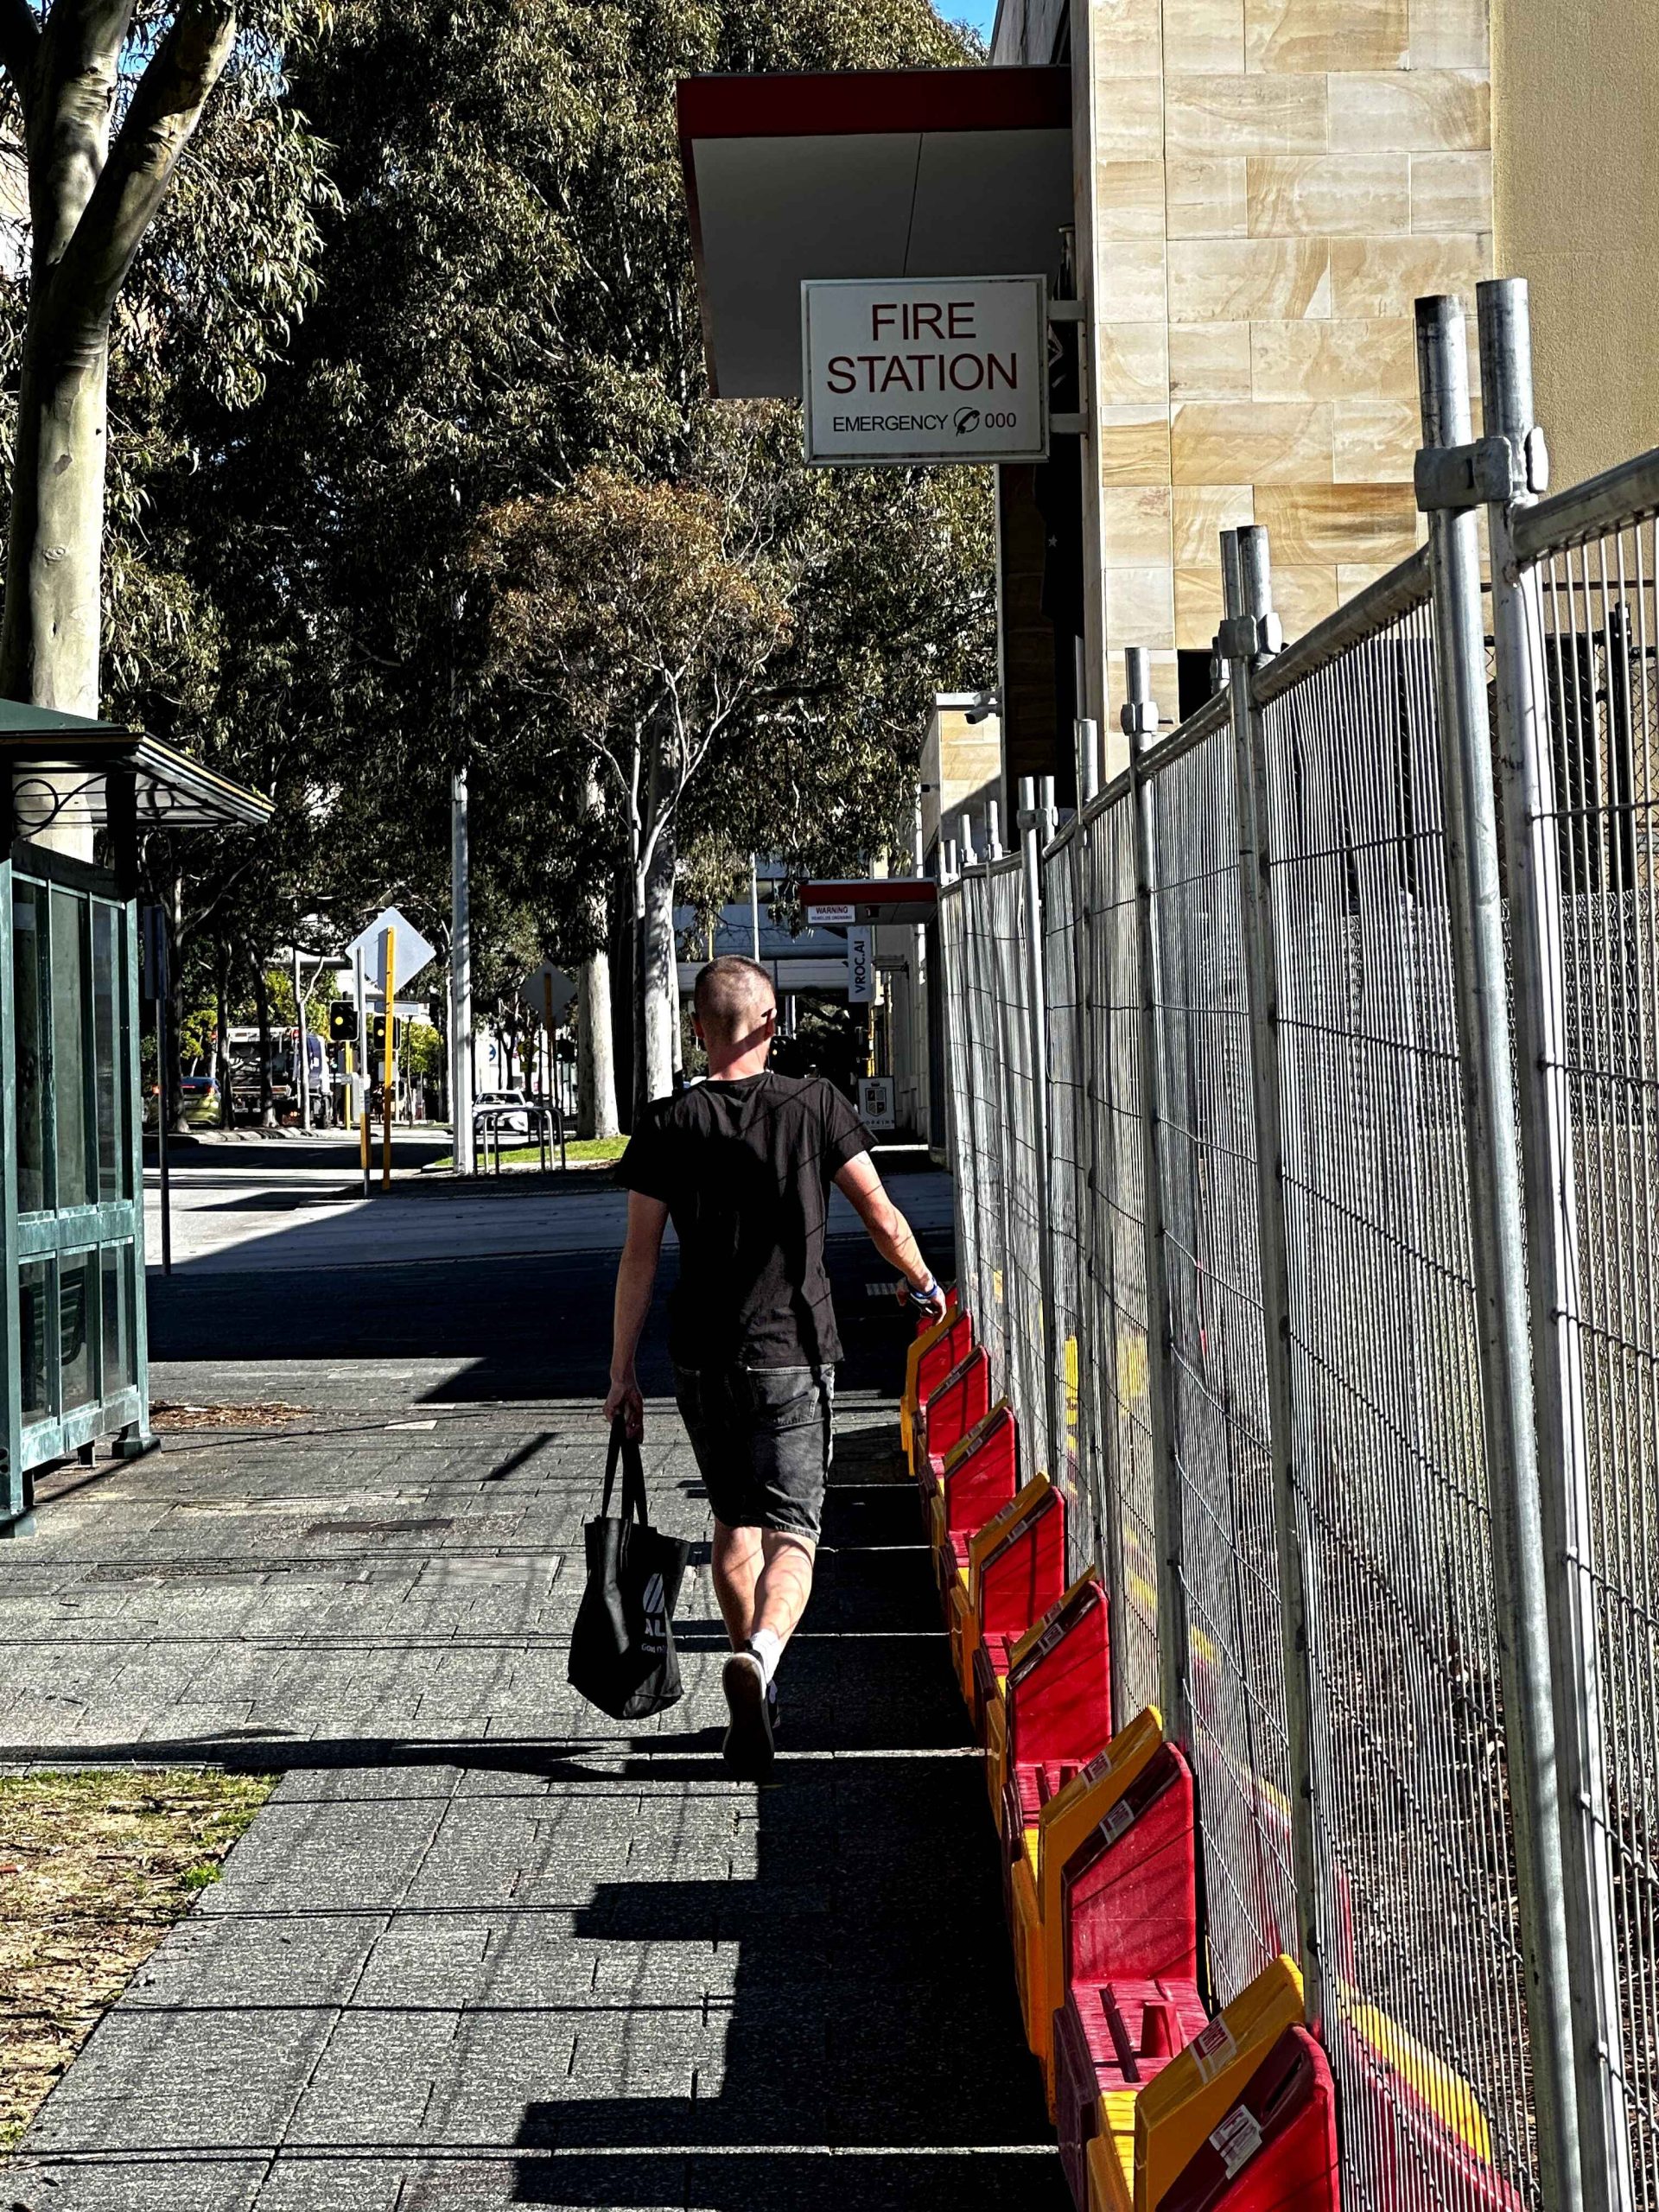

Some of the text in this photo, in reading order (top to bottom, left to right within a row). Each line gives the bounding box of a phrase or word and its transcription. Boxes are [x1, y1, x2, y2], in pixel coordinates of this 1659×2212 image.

[872, 302, 977, 341] FIRE
[826, 352, 1019, 394] STATION
[832, 412, 1017, 433] EMERGENCY 000
[815, 906, 849, 914] WARNING
[854, 940, 866, 994] VROC.AI
